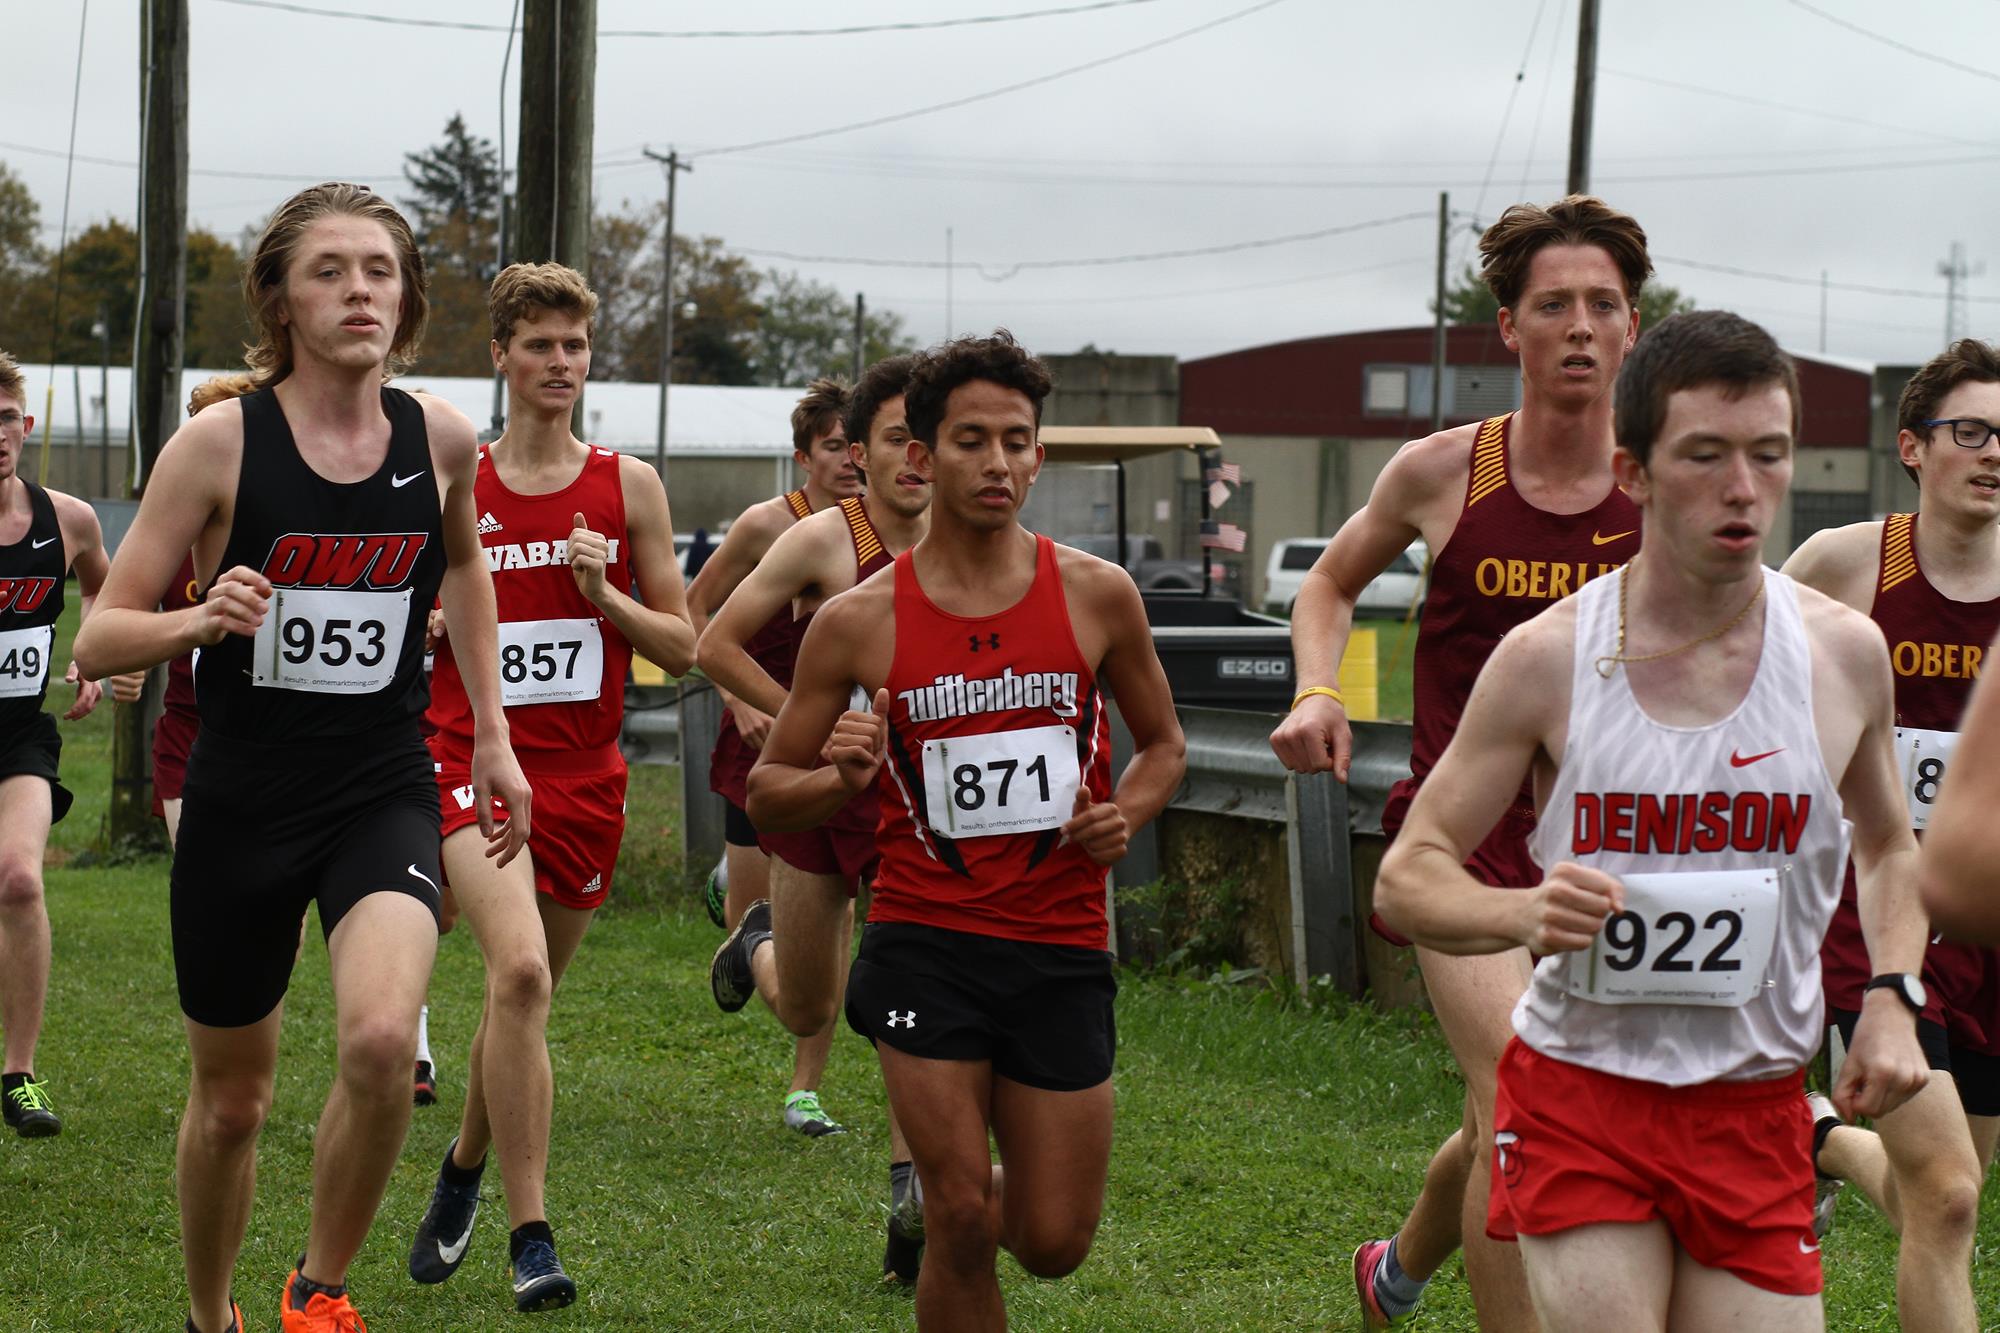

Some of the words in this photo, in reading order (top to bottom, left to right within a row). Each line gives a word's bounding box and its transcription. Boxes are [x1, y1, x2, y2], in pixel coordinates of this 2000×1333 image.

[477, 523, 504, 535] adidas
[260, 532, 429, 589] OWU
[481, 539, 620, 573] ABA
[1475, 557, 1626, 599] OBERL
[0, 646, 41, 679] 49
[282, 617, 386, 667] 953
[501, 640, 583, 684] 857
[1893, 641, 1983, 680] OBER
[952, 754, 1051, 811] 871
[1571, 791, 1812, 855] DENISON
[1603, 909, 1744, 973] 922
